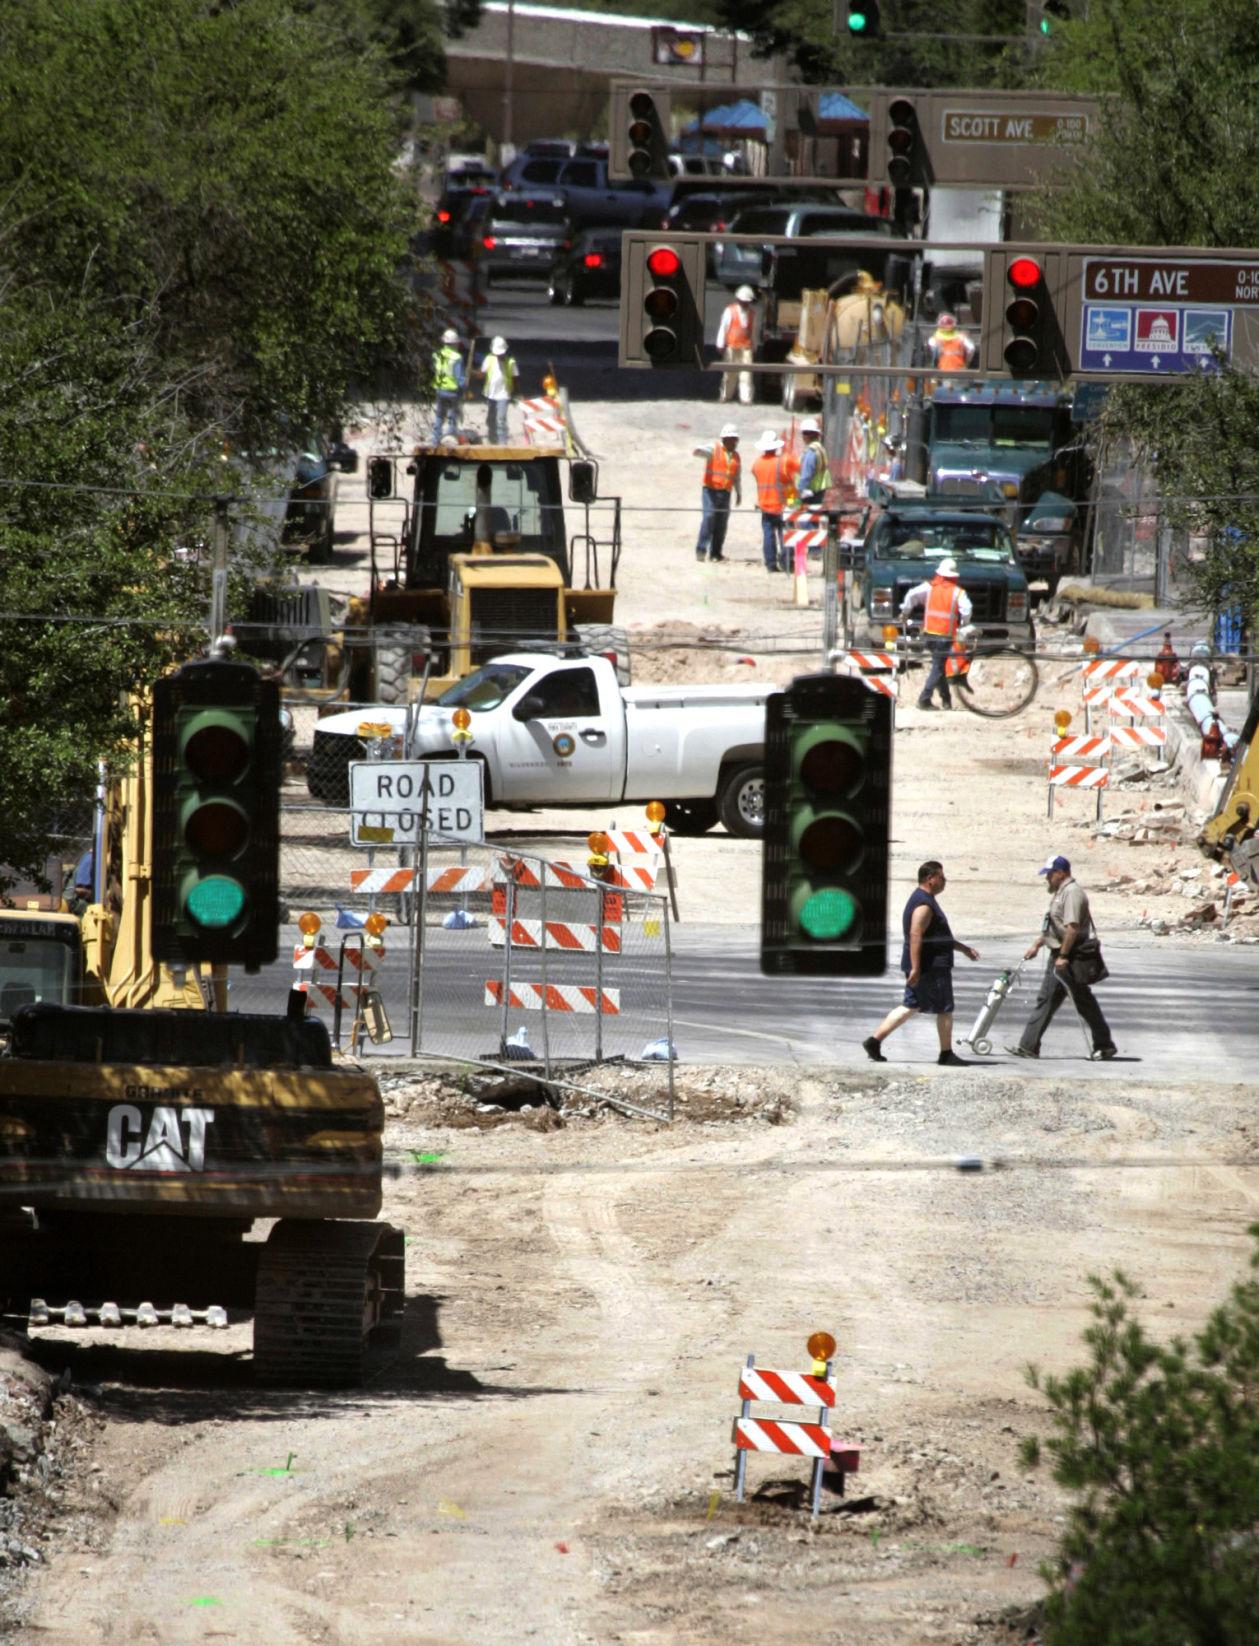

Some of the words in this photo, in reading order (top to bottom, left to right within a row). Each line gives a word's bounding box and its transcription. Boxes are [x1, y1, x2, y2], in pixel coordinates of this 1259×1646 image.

[951, 116, 1000, 137] SCOTT
[1005, 118, 1034, 138] AVE
[1094, 268, 1139, 294] 6TH
[1150, 270, 1190, 296] AVE
[1235, 286, 1259, 299] NOR
[377, 773, 455, 799] ROAD
[106, 1104, 215, 1172] CAT
